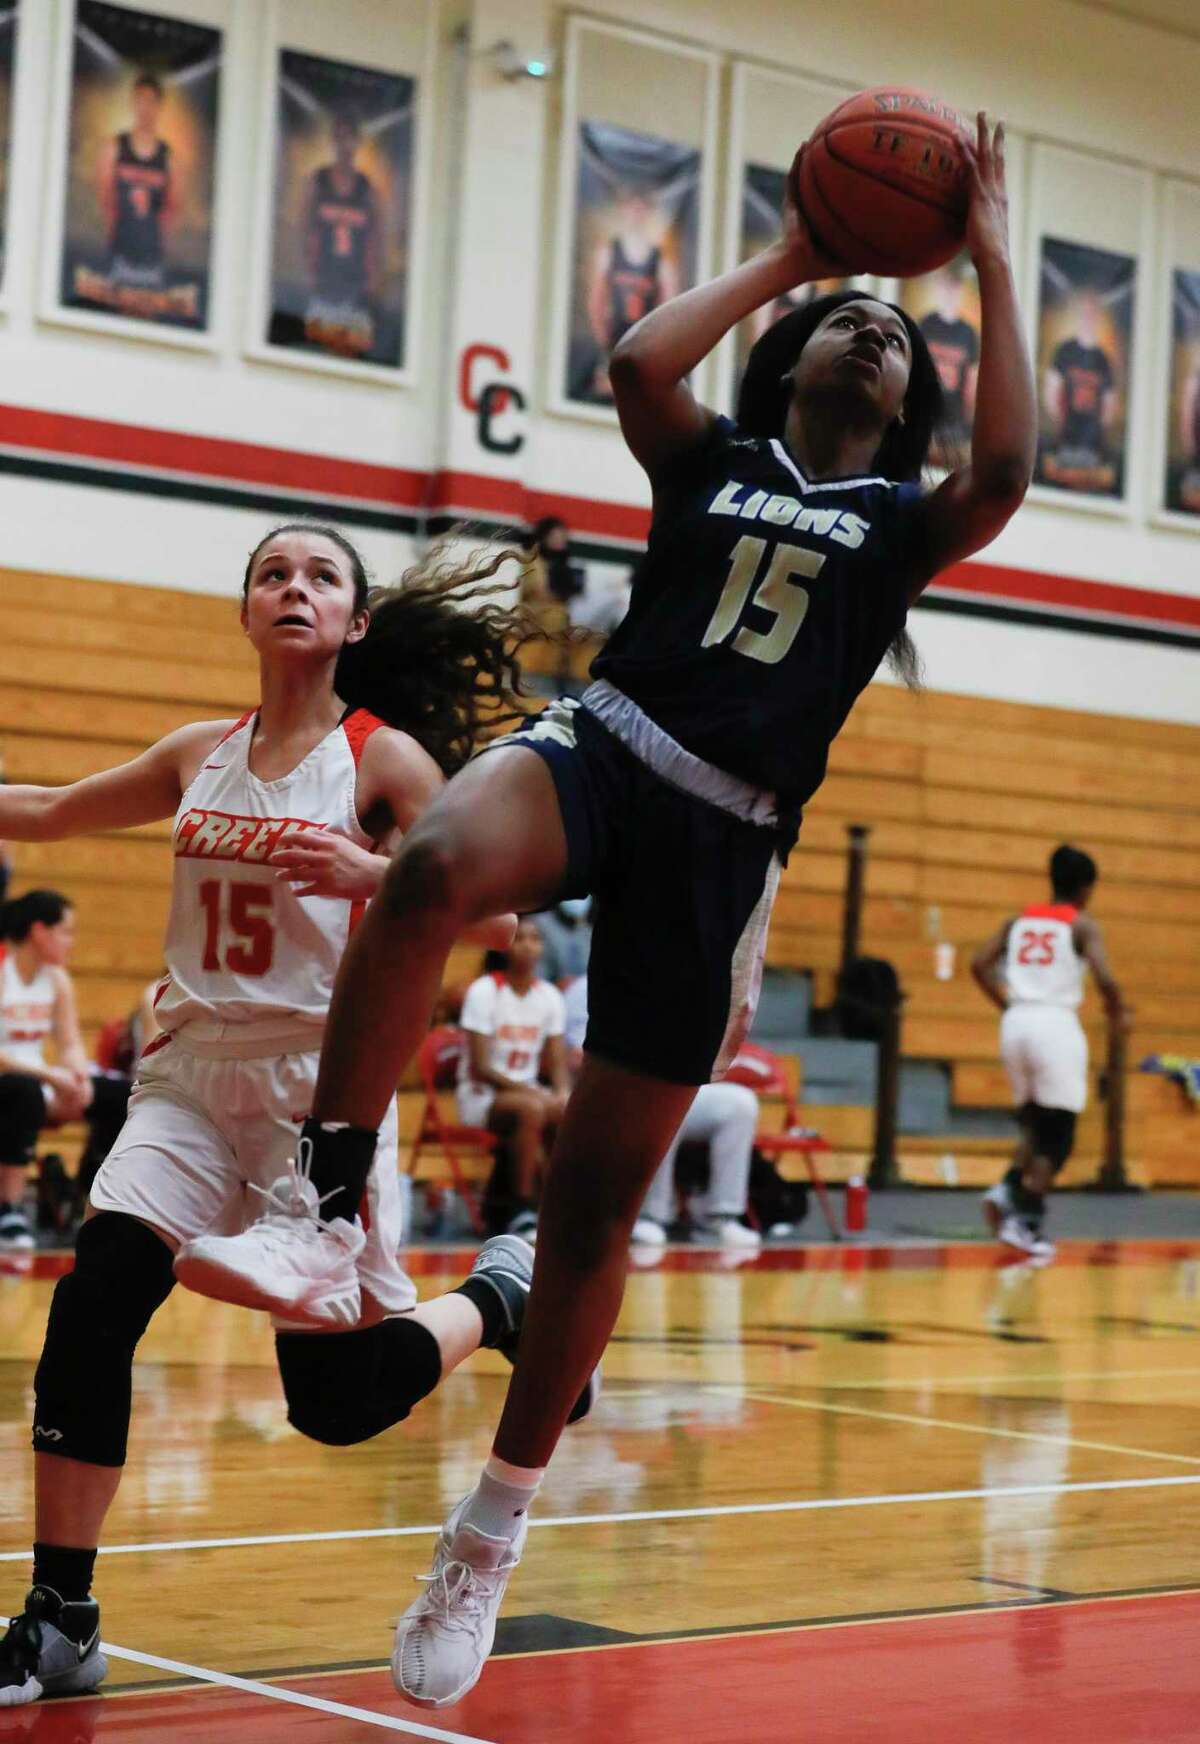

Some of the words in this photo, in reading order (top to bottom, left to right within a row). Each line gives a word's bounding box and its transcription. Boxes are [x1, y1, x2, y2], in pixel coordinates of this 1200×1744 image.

[707, 480, 871, 549] LIONS
[701, 534, 827, 664] 15
[200, 879, 274, 977] 15
[1018, 931, 1054, 966] 25
